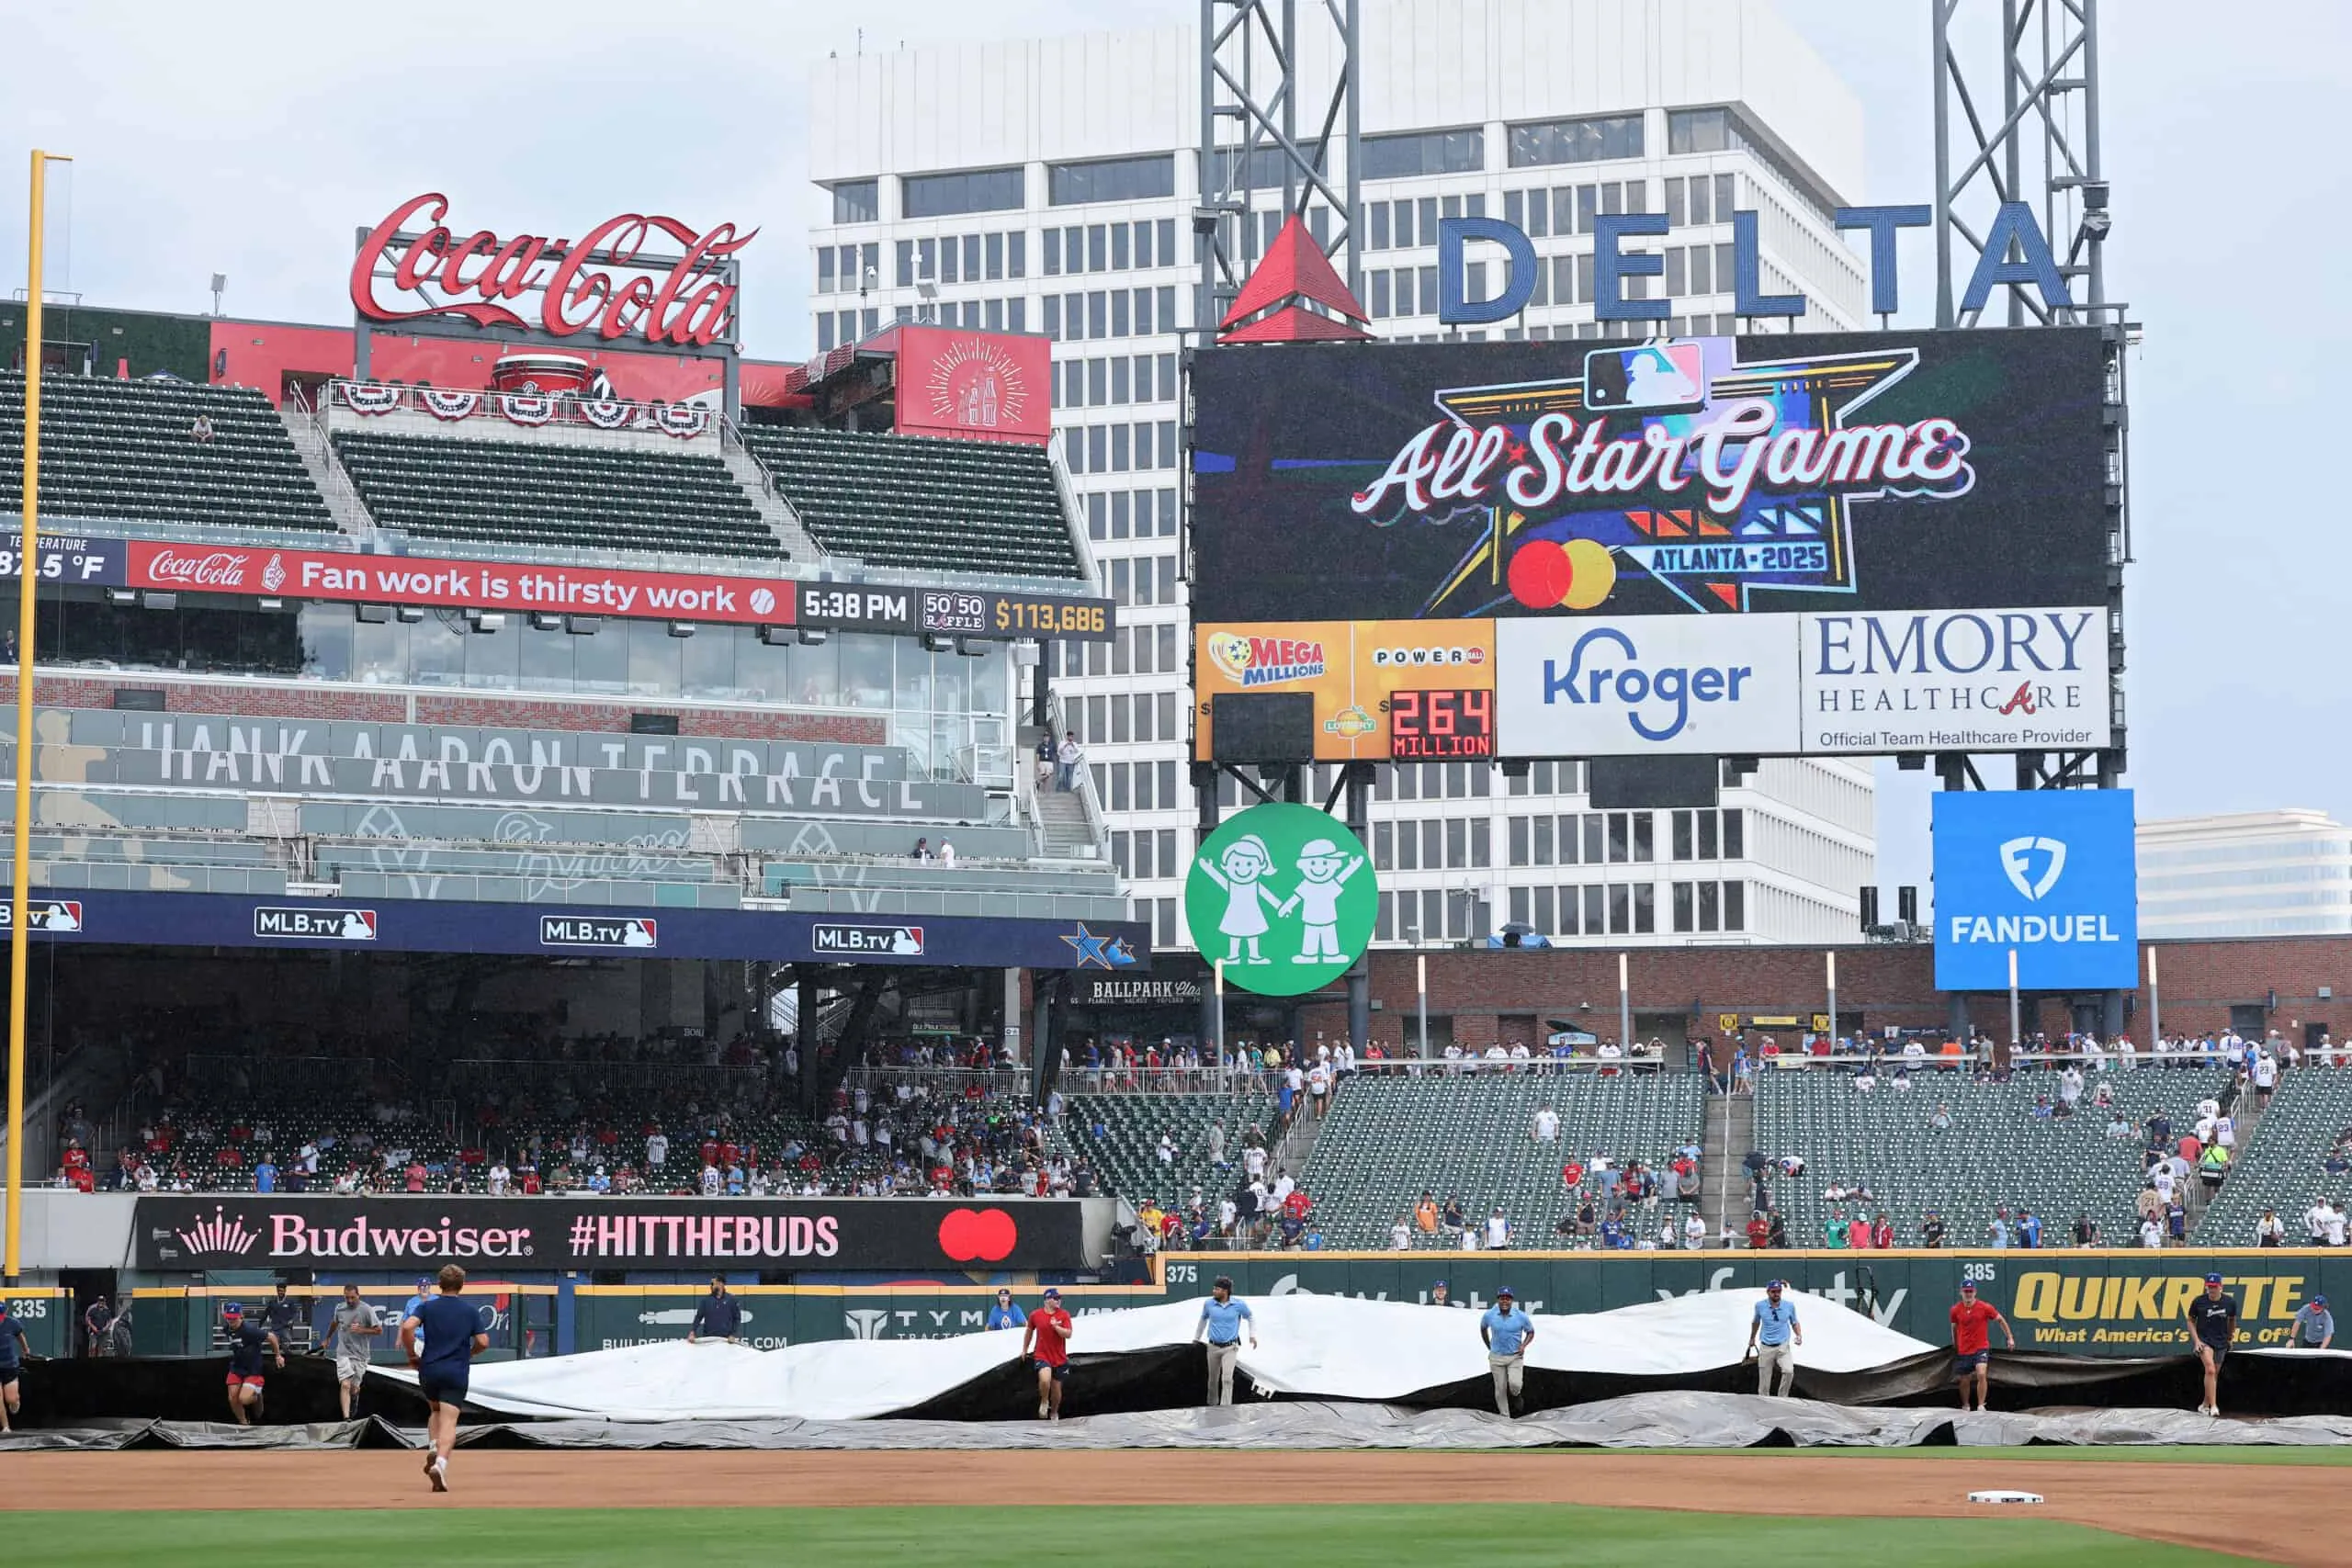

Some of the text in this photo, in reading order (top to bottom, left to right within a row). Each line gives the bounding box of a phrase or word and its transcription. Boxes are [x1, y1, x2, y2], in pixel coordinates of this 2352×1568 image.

[350, 192, 761, 345] Coca-Cola
[1439, 200, 2073, 324] DELTA
[1351, 399, 1963, 513] All Star Game
[149, 550, 248, 586] Coca-Cola
[1653, 543, 1826, 571] ATLANTA 2025
[302, 561, 736, 612] Fan work is thirsty work
[805, 591, 907, 622] 5:38 PM
[996, 599, 1105, 633] $113,686
[925, 614, 983, 628] RAFFLE
[1250, 637, 1324, 668] MEGA
[1815, 613, 2094, 675] EMORY
[1243, 664, 1324, 686] MILLIONS
[1544, 627, 1751, 741] Kroger
[1201, 702, 1211, 716] $
[1380, 700, 1390, 714] $
[1819, 680, 2081, 716] HEALTHCARE
[1394, 692, 1489, 735] 264
[1394, 736, 1489, 756] MILLION
[1820, 729, 2092, 746] Official Team Healthcare Provider
[142, 722, 922, 809] HANK AARON TERRACE
[260, 913, 340, 935] MLB.TV
[546, 920, 623, 942] MLB.TV
[1951, 914, 2120, 943] FANDUEL
[818, 929, 891, 950] MLB.TV
[1093, 981, 1173, 998] BALLPARK
[2259, 1066, 2270, 1075] 23
[2218, 1124, 2229, 1133] 23
[269, 1214, 840, 1258] Budweiser #HITTHEBUDS
[1167, 1265, 1198, 1282] 375
[1963, 1264, 1996, 1280] 385
[12, 1299, 46, 1318] 335
[895, 1310, 983, 1326] TYM
[2035, 1328, 2086, 1342] What
[2092, 1328, 2189, 1342] America's
